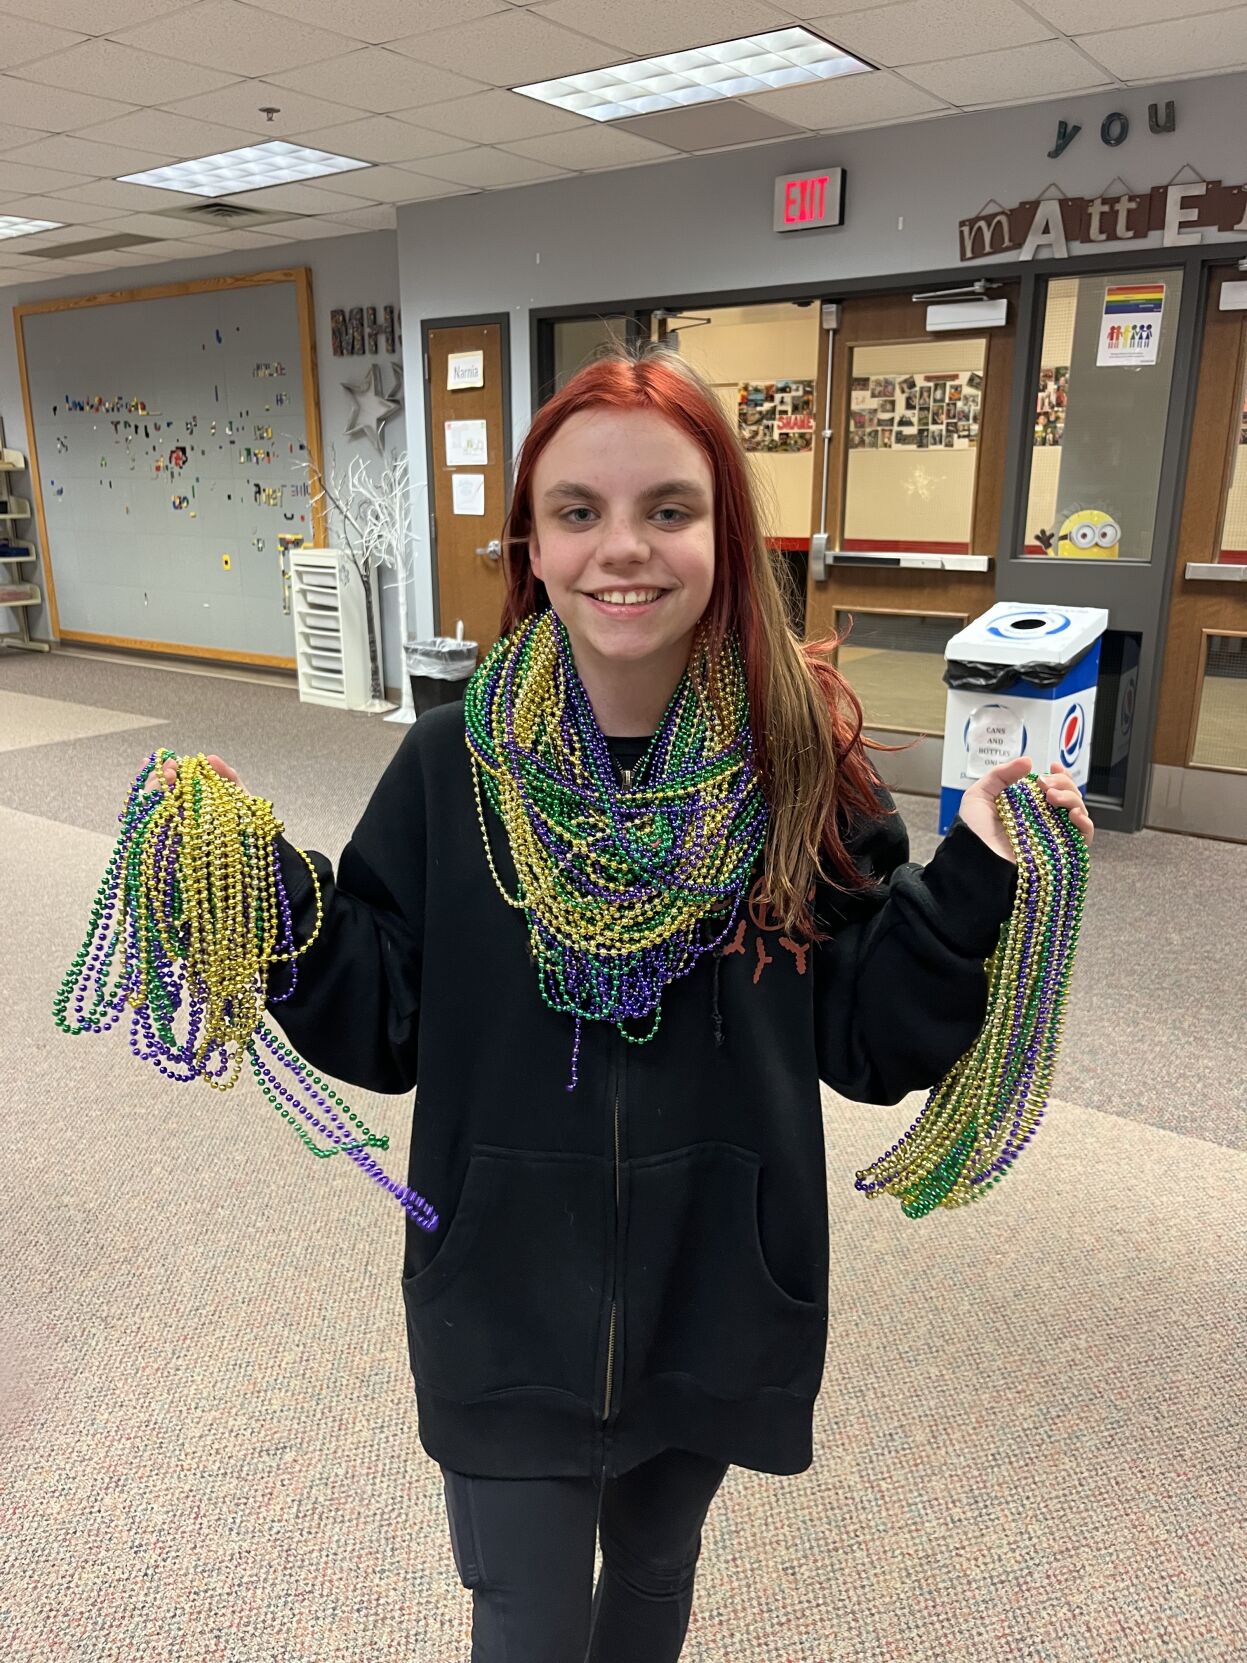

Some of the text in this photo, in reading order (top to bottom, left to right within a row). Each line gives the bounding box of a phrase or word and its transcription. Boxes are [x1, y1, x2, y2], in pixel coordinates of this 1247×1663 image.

[784, 175, 830, 225] EXIT
[330, 304, 401, 358] MH
[453, 365, 479, 381] Narnia
[986, 726, 1006, 735] CANS
[987, 737, 1004, 745] AND
[978, 746, 1011, 757] BOTTLES
